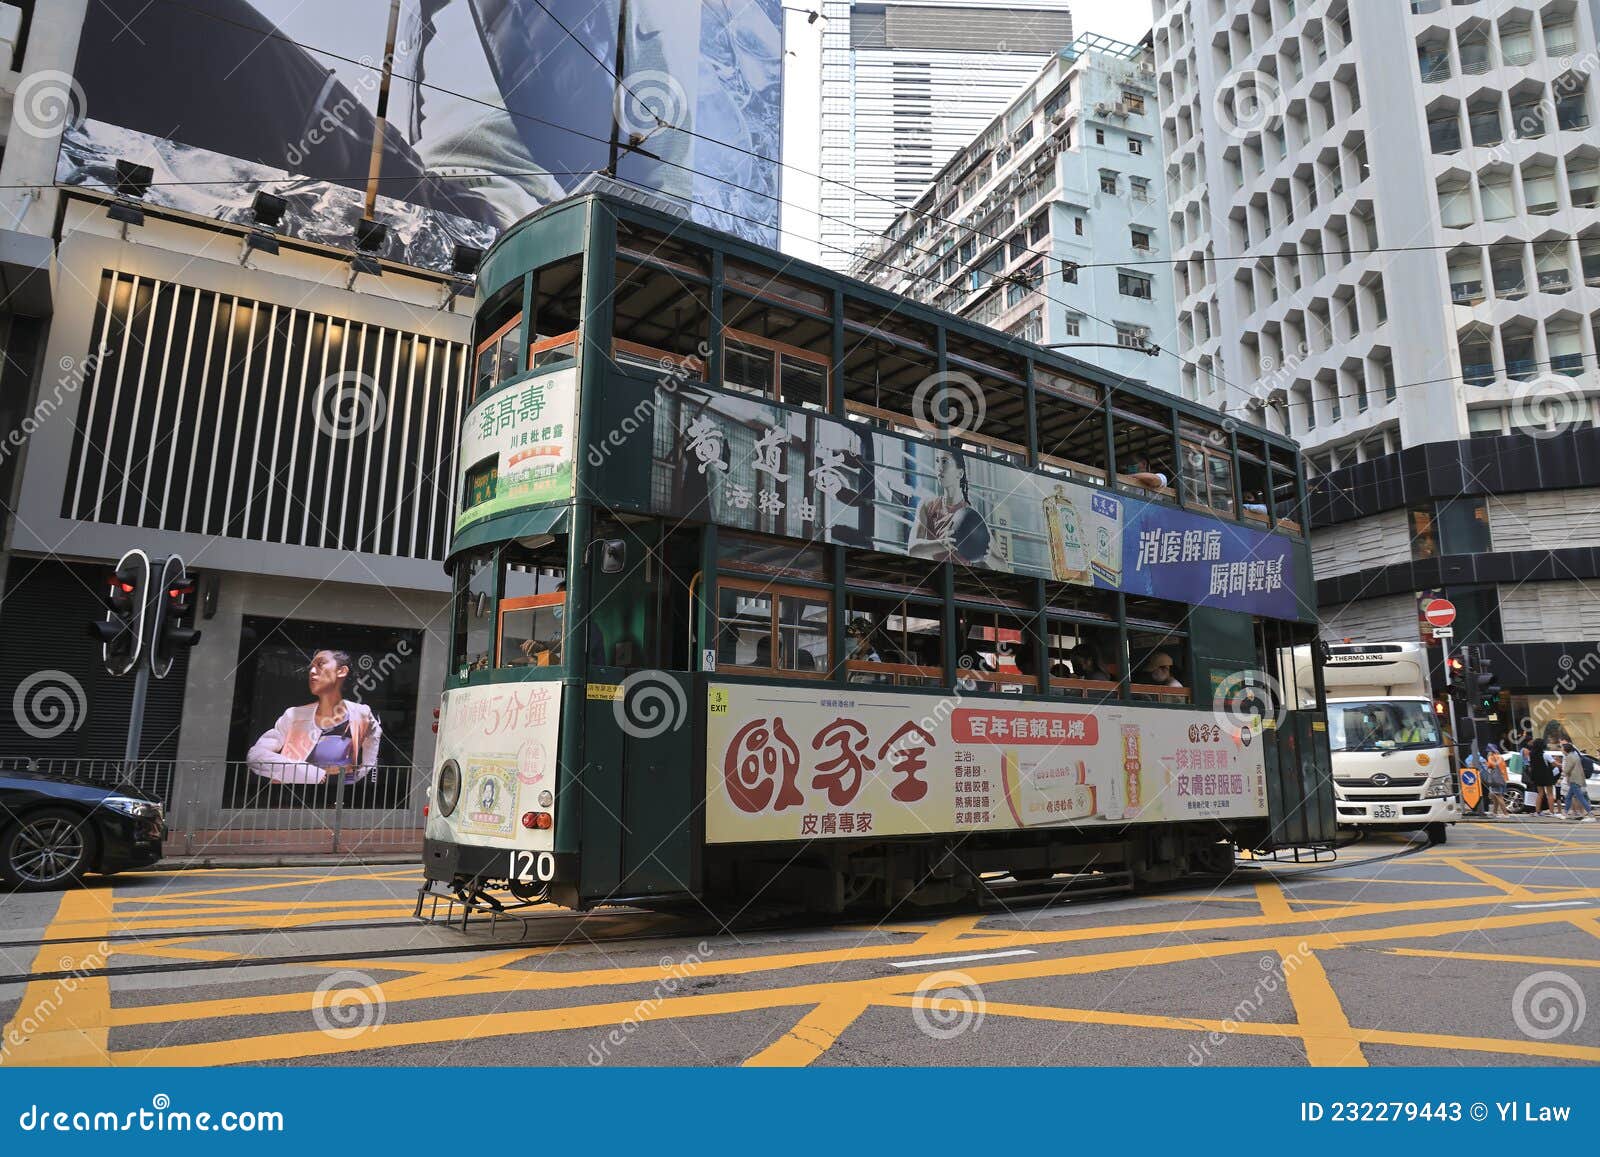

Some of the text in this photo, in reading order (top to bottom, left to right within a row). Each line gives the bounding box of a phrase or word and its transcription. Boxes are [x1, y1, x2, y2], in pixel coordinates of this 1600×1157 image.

[1210, 554, 1285, 598] 瞬間輕鬆
[711, 704, 727, 713] EXIT
[968, 716, 1085, 740] 百年信賴品牌
[801, 812, 872, 835] 皮膚專家
[509, 850, 555, 881] 120
